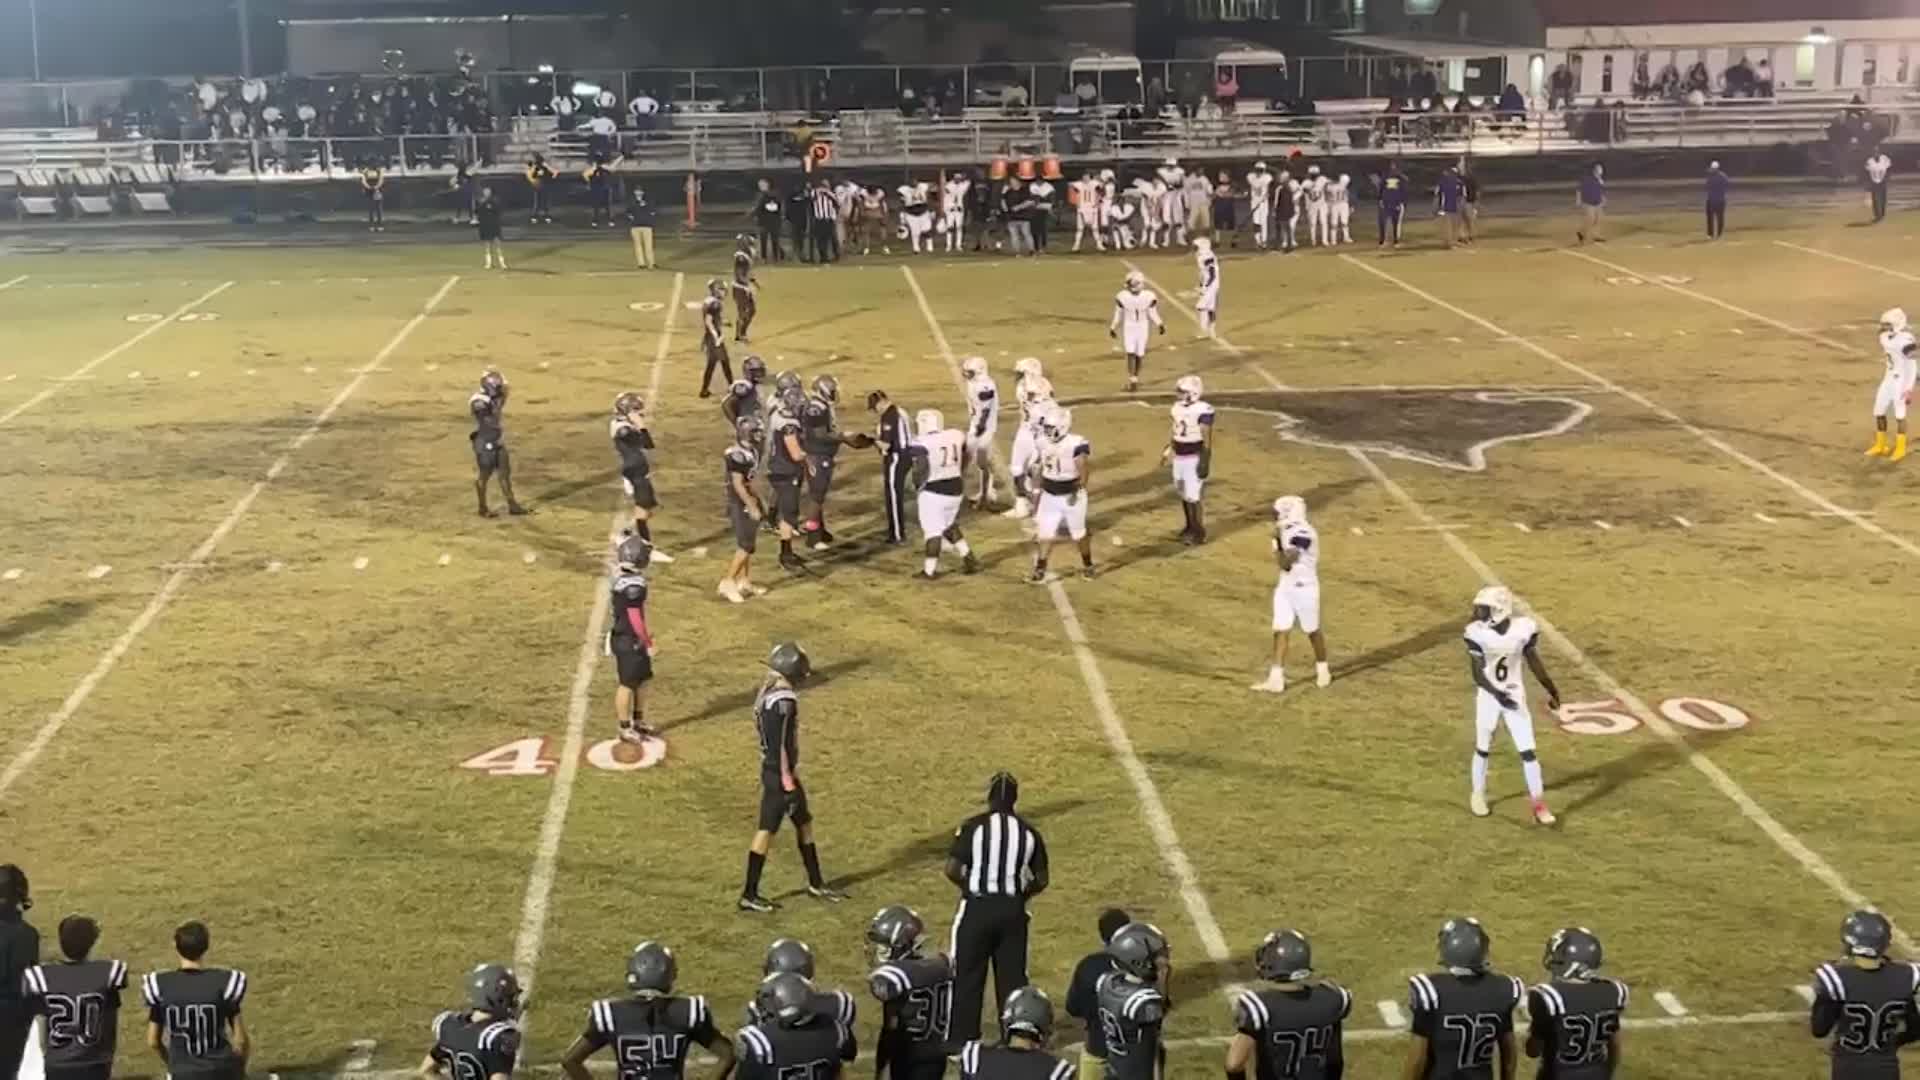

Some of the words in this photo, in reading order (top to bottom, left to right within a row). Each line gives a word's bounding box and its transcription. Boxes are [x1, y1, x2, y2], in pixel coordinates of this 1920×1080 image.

[1495, 656, 1508, 683] 6
[1552, 697, 1751, 736] 50
[459, 736, 668, 776] 40
[46, 993, 103, 1047] 20
[166, 1004, 217, 1056] 41
[1443, 1013, 1502, 1069] 72
[1272, 1024, 1333, 1074] 74
